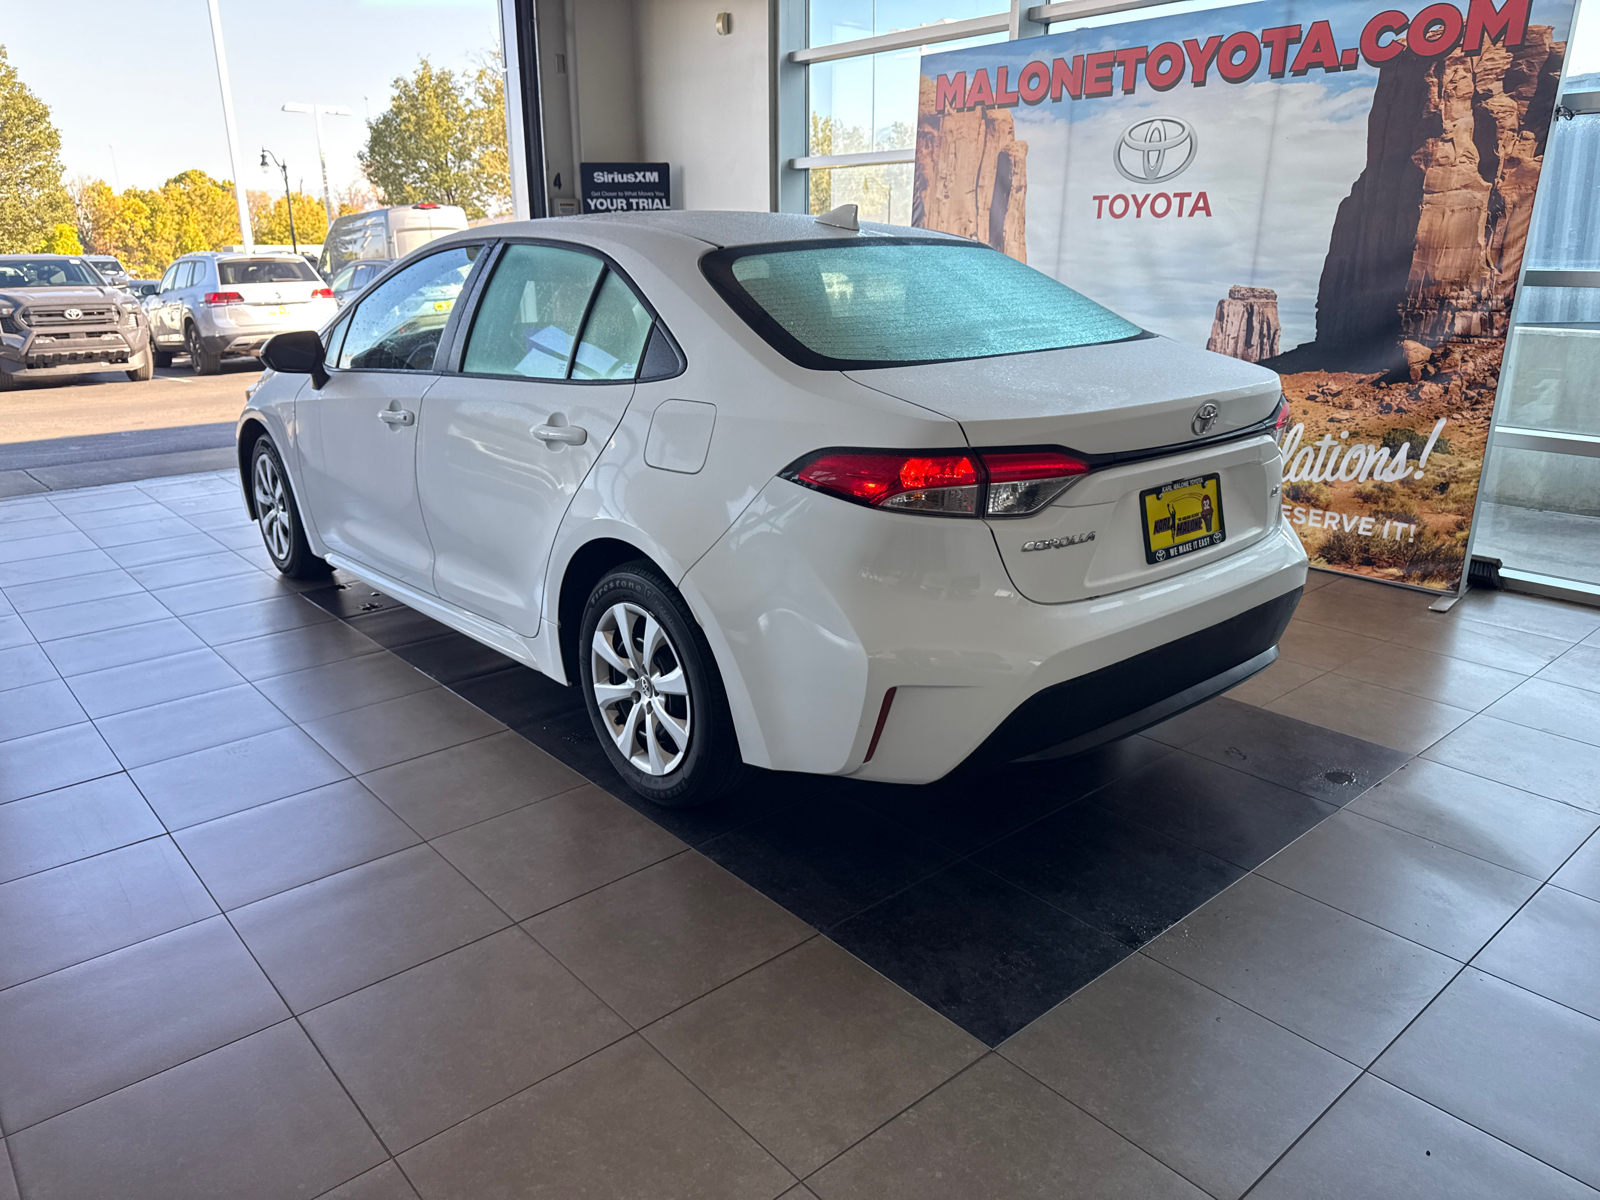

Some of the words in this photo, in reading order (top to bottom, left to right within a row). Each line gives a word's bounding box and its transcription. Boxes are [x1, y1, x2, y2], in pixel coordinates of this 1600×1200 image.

[935, 0, 1532, 113] MALONETOYOTA.COM
[553, 172, 562, 190] 4
[593, 171, 659, 183] SiriusXM
[587, 198, 627, 210] YOUR
[629, 198, 670, 210] TRIAL
[1092, 191, 1212, 219] TOYOTA
[1203, 499, 1210, 510] 32
[1021, 530, 1096, 552] COROLLA
[1382, 520, 1417, 543] IT!
[1169, 547, 1178, 557] WE
[1178, 542, 1193, 553] MAKE
[1193, 541, 1198, 550] IT
[1198, 537, 1210, 548] EASY
